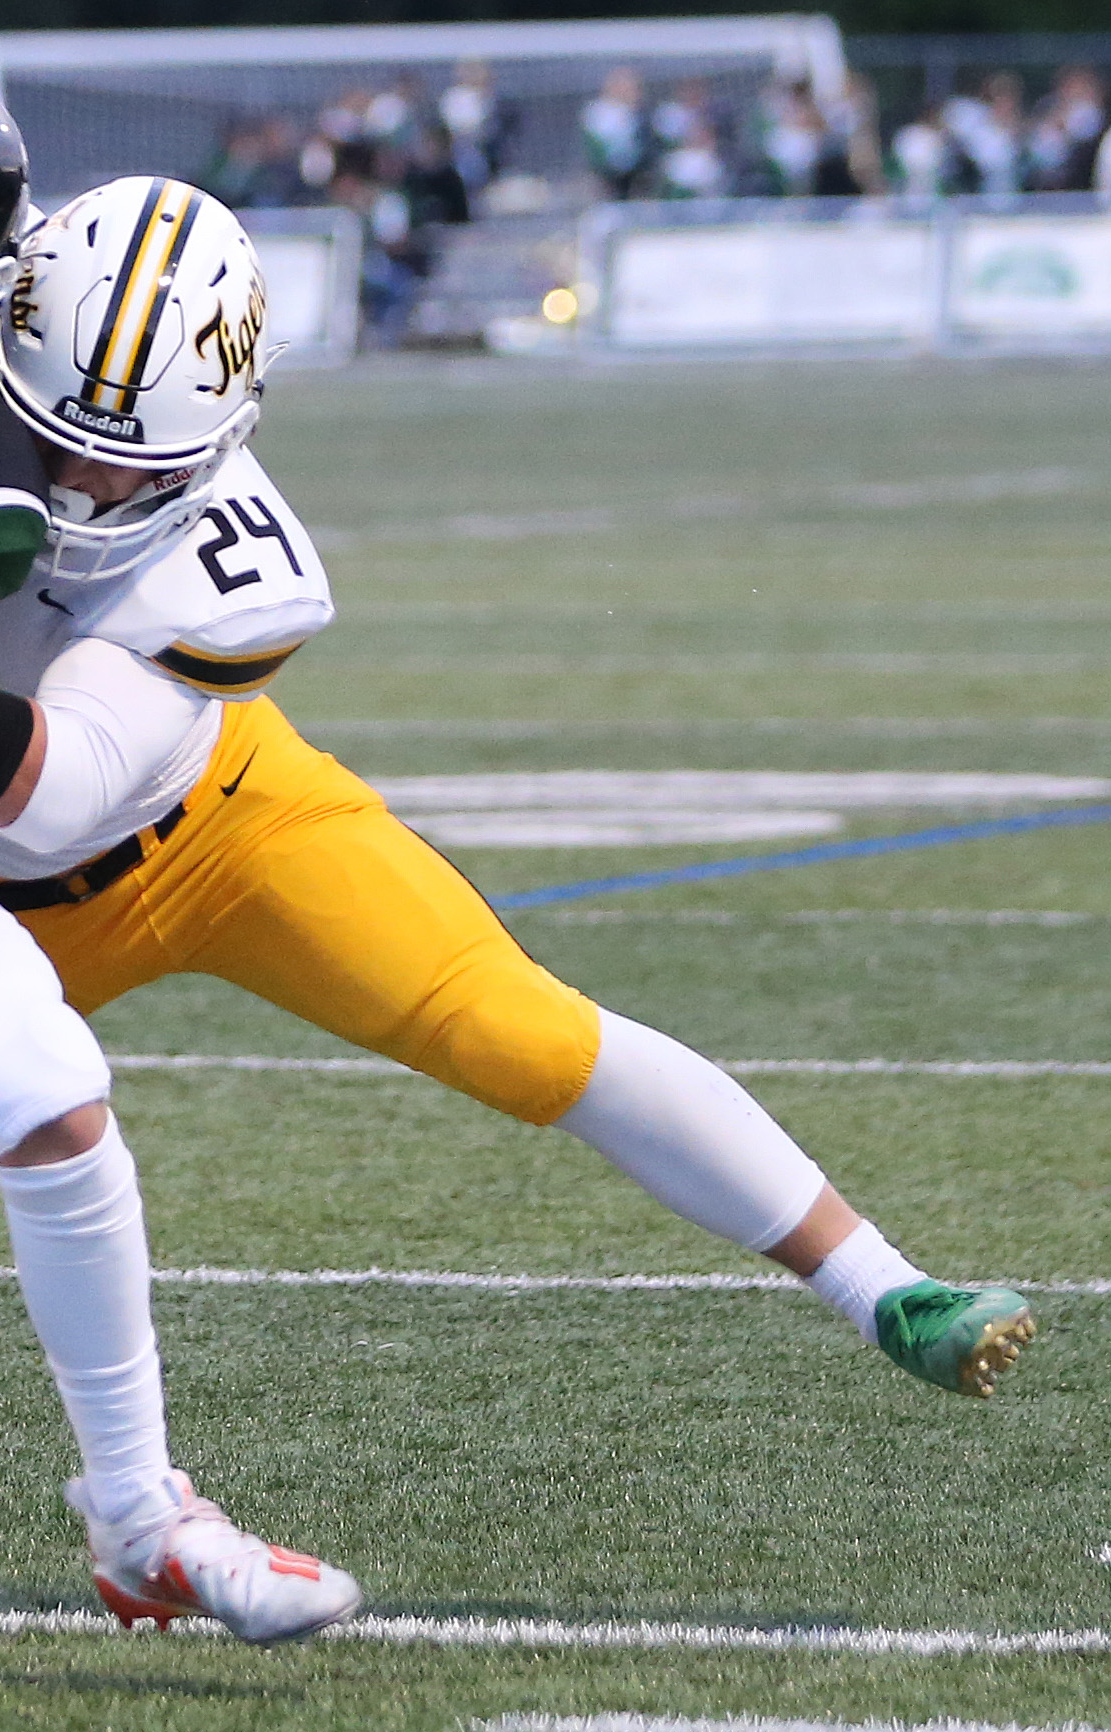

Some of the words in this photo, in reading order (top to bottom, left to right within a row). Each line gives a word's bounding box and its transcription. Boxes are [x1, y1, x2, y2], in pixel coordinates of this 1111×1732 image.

[195, 260, 267, 396] Tiger
[63, 400, 136, 435] Riddell
[154, 468, 195, 491] Ridd
[197, 496, 304, 595] 24
